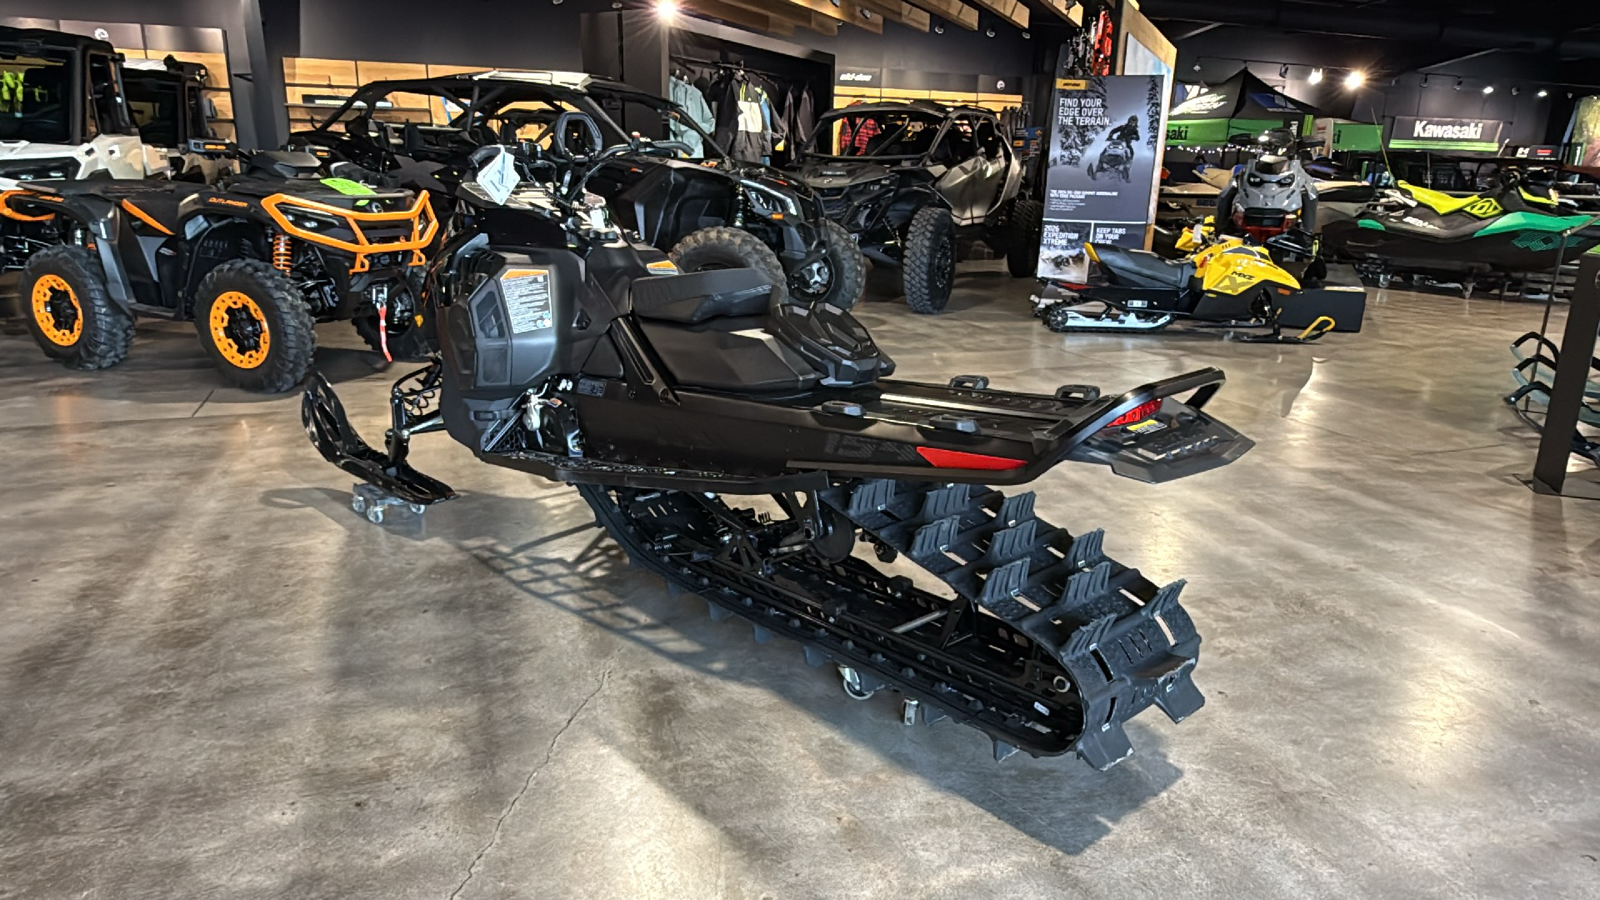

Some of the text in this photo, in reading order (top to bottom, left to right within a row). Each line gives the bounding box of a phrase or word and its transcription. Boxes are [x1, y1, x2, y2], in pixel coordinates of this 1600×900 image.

[1060, 98, 1102, 107] FIND YOUR
[1059, 107, 1103, 116] EDGE OVER
[1058, 116, 1112, 125] THE TERRAIN.
[1413, 121, 1483, 139] Kawasaki
[208, 197, 249, 207] OUTLANDER
[1043, 232, 1079, 240] EXPEDITION
